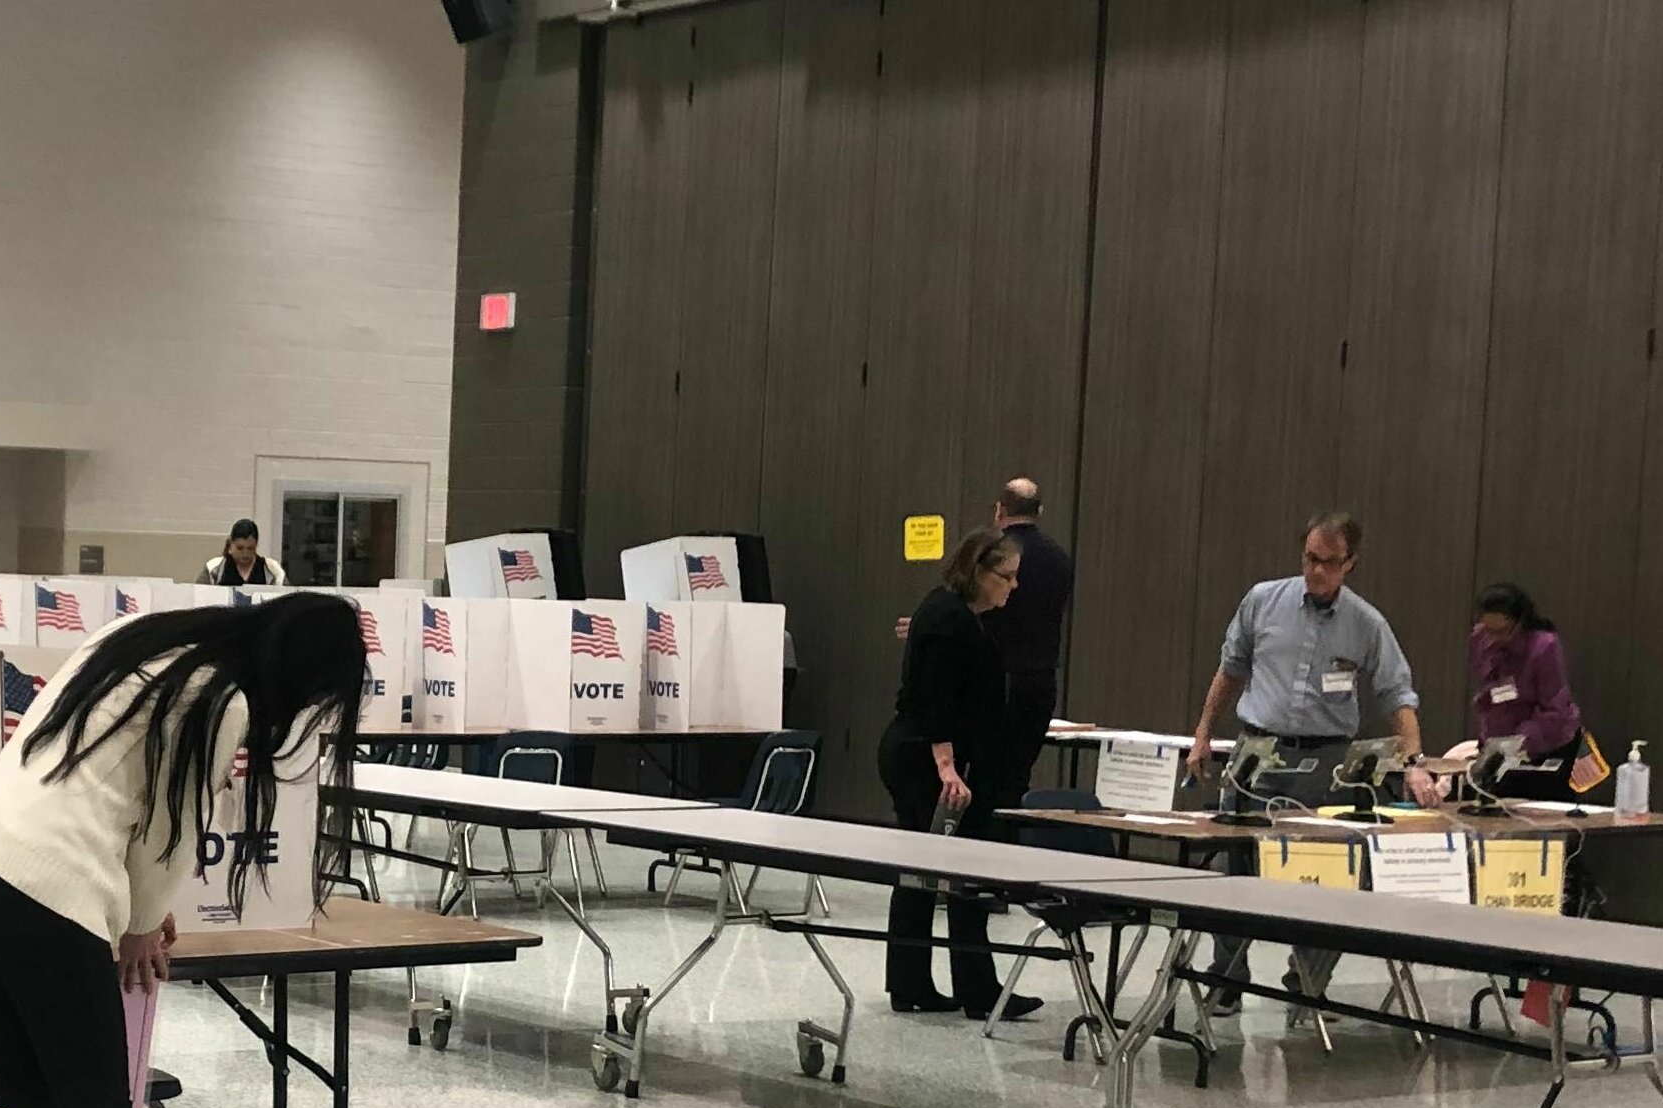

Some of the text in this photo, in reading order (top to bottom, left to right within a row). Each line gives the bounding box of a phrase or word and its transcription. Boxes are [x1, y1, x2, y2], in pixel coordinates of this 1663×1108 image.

[363, 679, 386, 696] TE
[424, 679, 456, 698] VOTE
[573, 683, 625, 699] VOTE
[649, 680, 680, 699] VOTE
[196, 831, 279, 866] OTE
